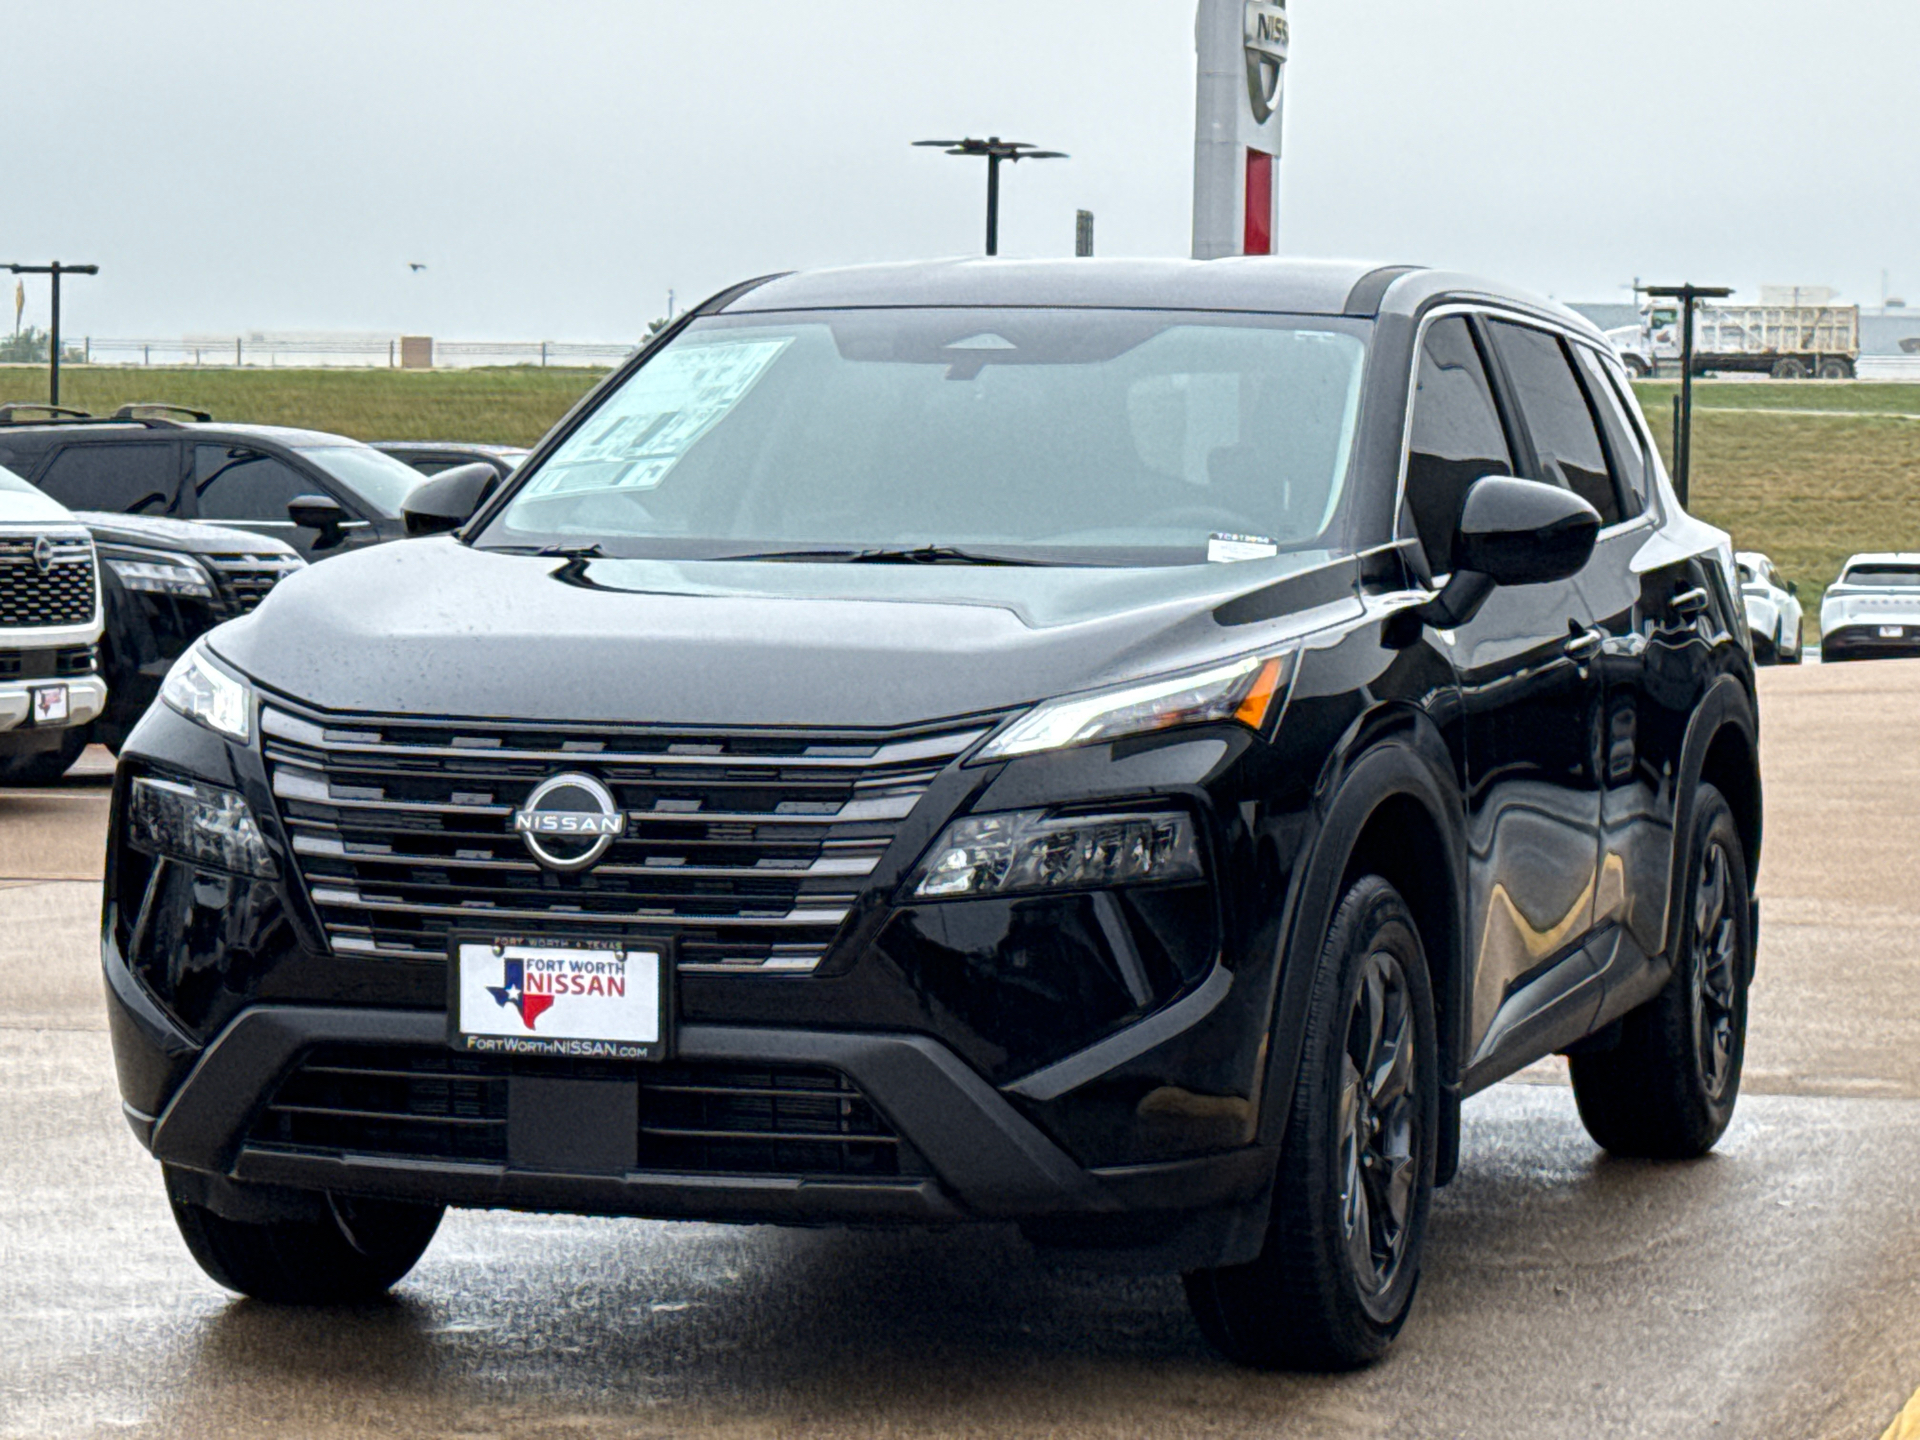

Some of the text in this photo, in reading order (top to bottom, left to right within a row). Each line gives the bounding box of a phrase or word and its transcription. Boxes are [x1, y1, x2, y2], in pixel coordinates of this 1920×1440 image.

[517, 814, 620, 832] NISSAN
[586, 940, 623, 950] TEXAS
[526, 958, 626, 975] FORT WORTH
[526, 973, 626, 998] NISSAN
